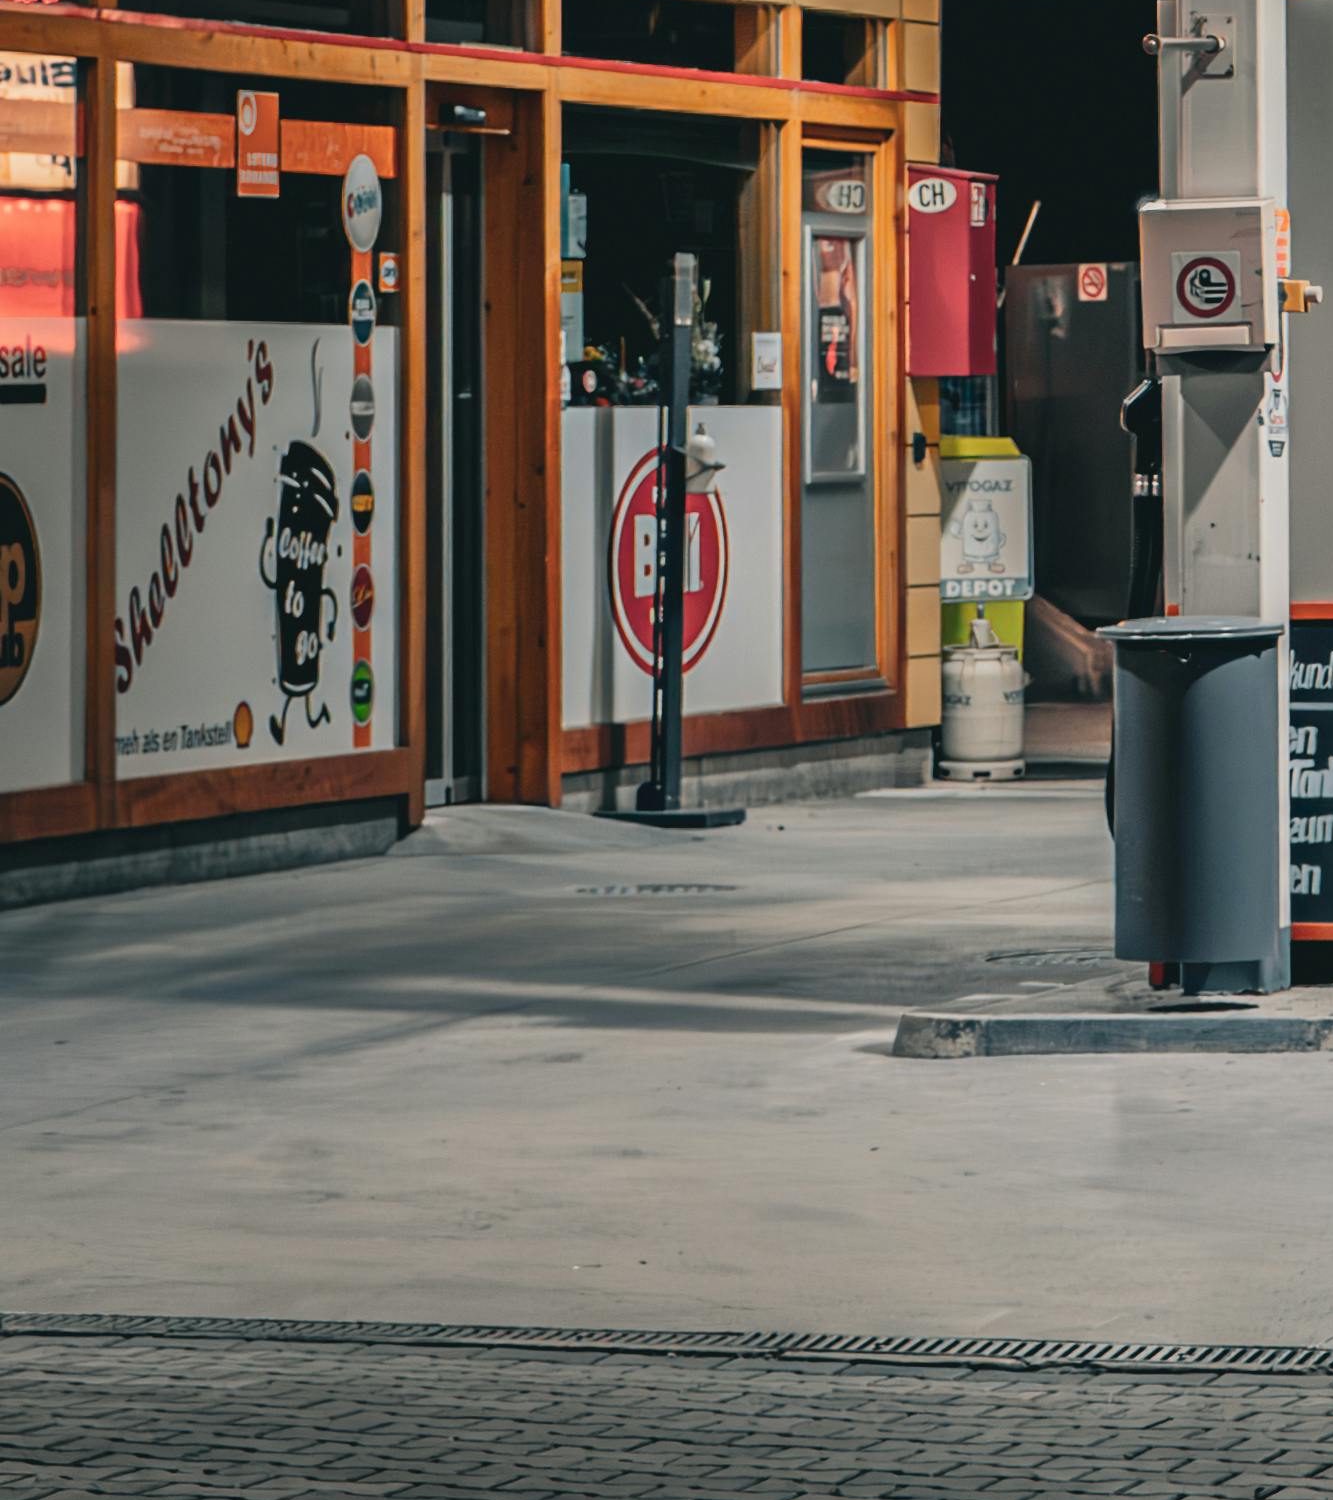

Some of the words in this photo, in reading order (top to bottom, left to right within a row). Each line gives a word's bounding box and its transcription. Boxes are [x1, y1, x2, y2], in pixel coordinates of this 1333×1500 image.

[919, 182, 946, 207] CH
[945, 480, 1014, 493] VITOGAZ
[279, 527, 326, 570] Coffee
[285, 580, 304, 618] to
[945, 580, 1016, 598] DEPOT
[295, 630, 318, 666] go
